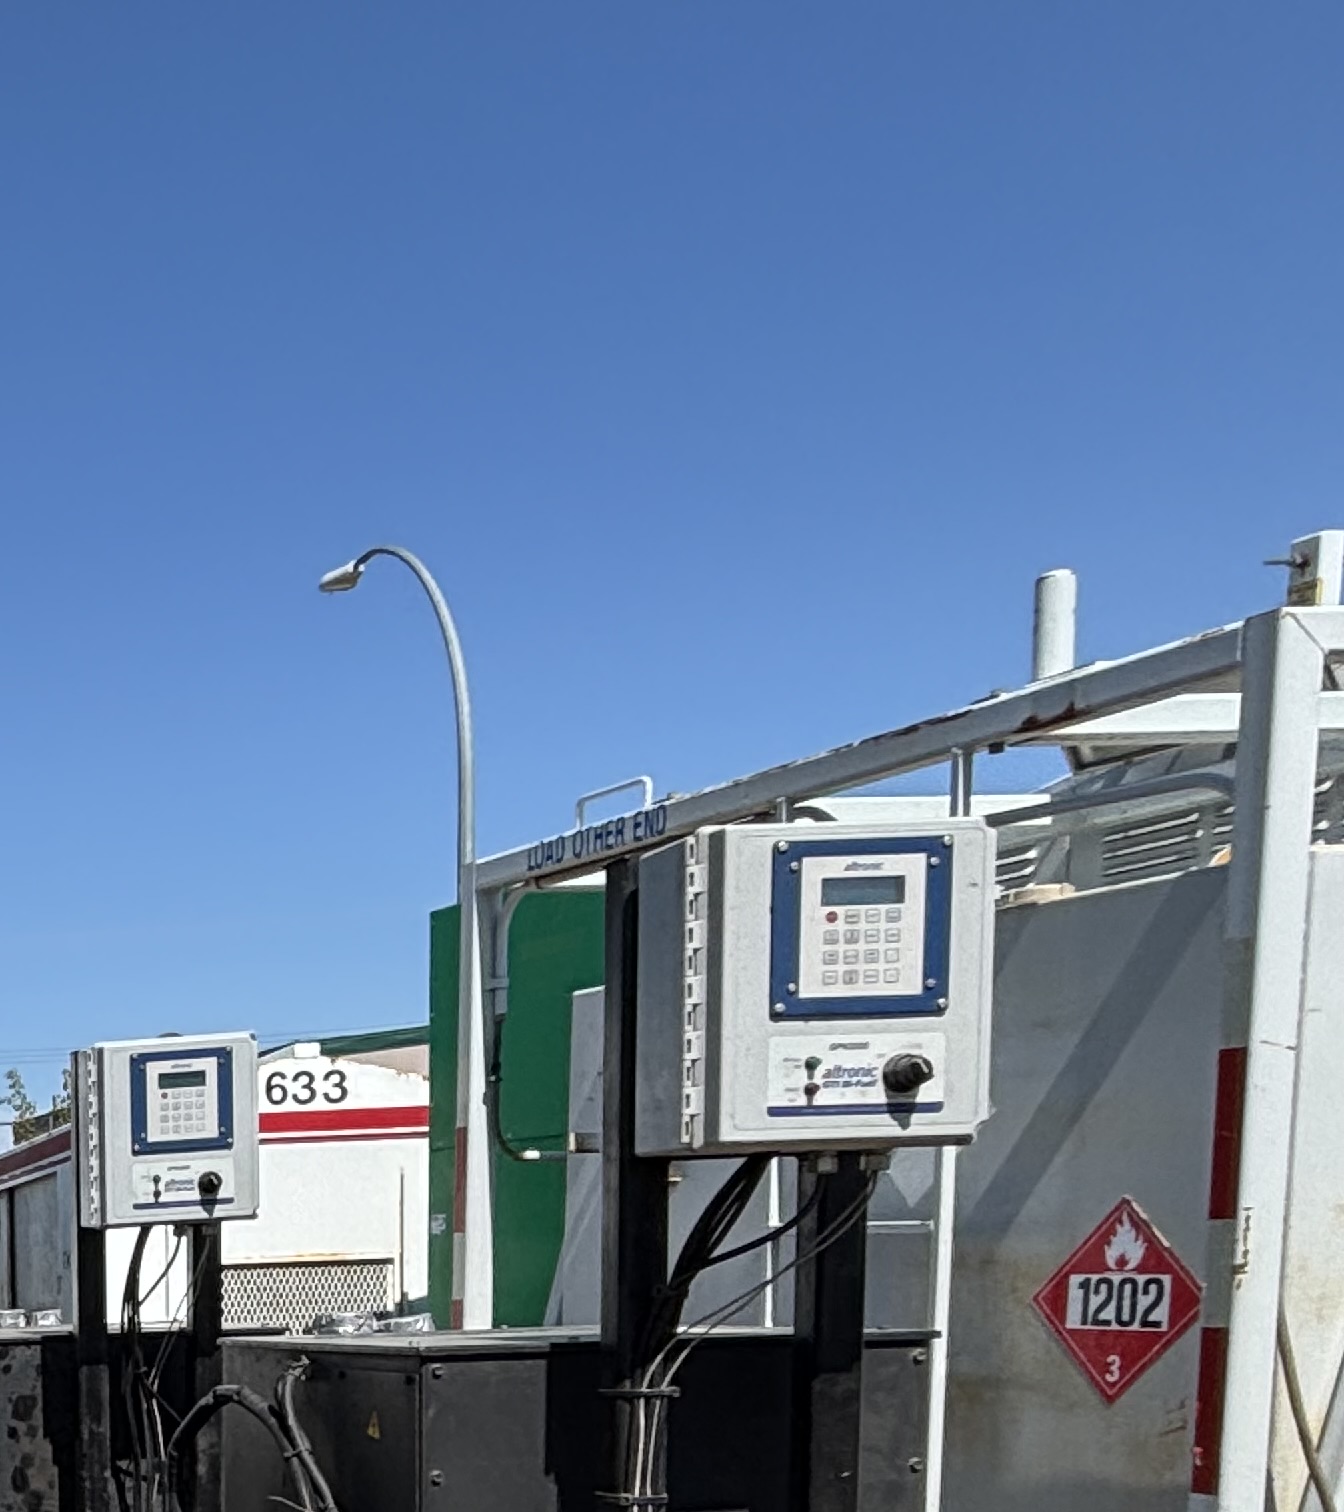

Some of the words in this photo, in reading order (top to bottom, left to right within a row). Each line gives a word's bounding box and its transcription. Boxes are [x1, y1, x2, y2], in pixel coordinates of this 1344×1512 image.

[527, 836, 566, 871] LOAD
[573, 817, 626, 859] OTHER
[633, 805, 668, 842] END
[266, 1070, 348, 1105] 633
[822, 1065, 879, 1079] altronic
[1078, 1277, 1165, 1328] 1202
[1105, 1355, 1121, 1382] 3
